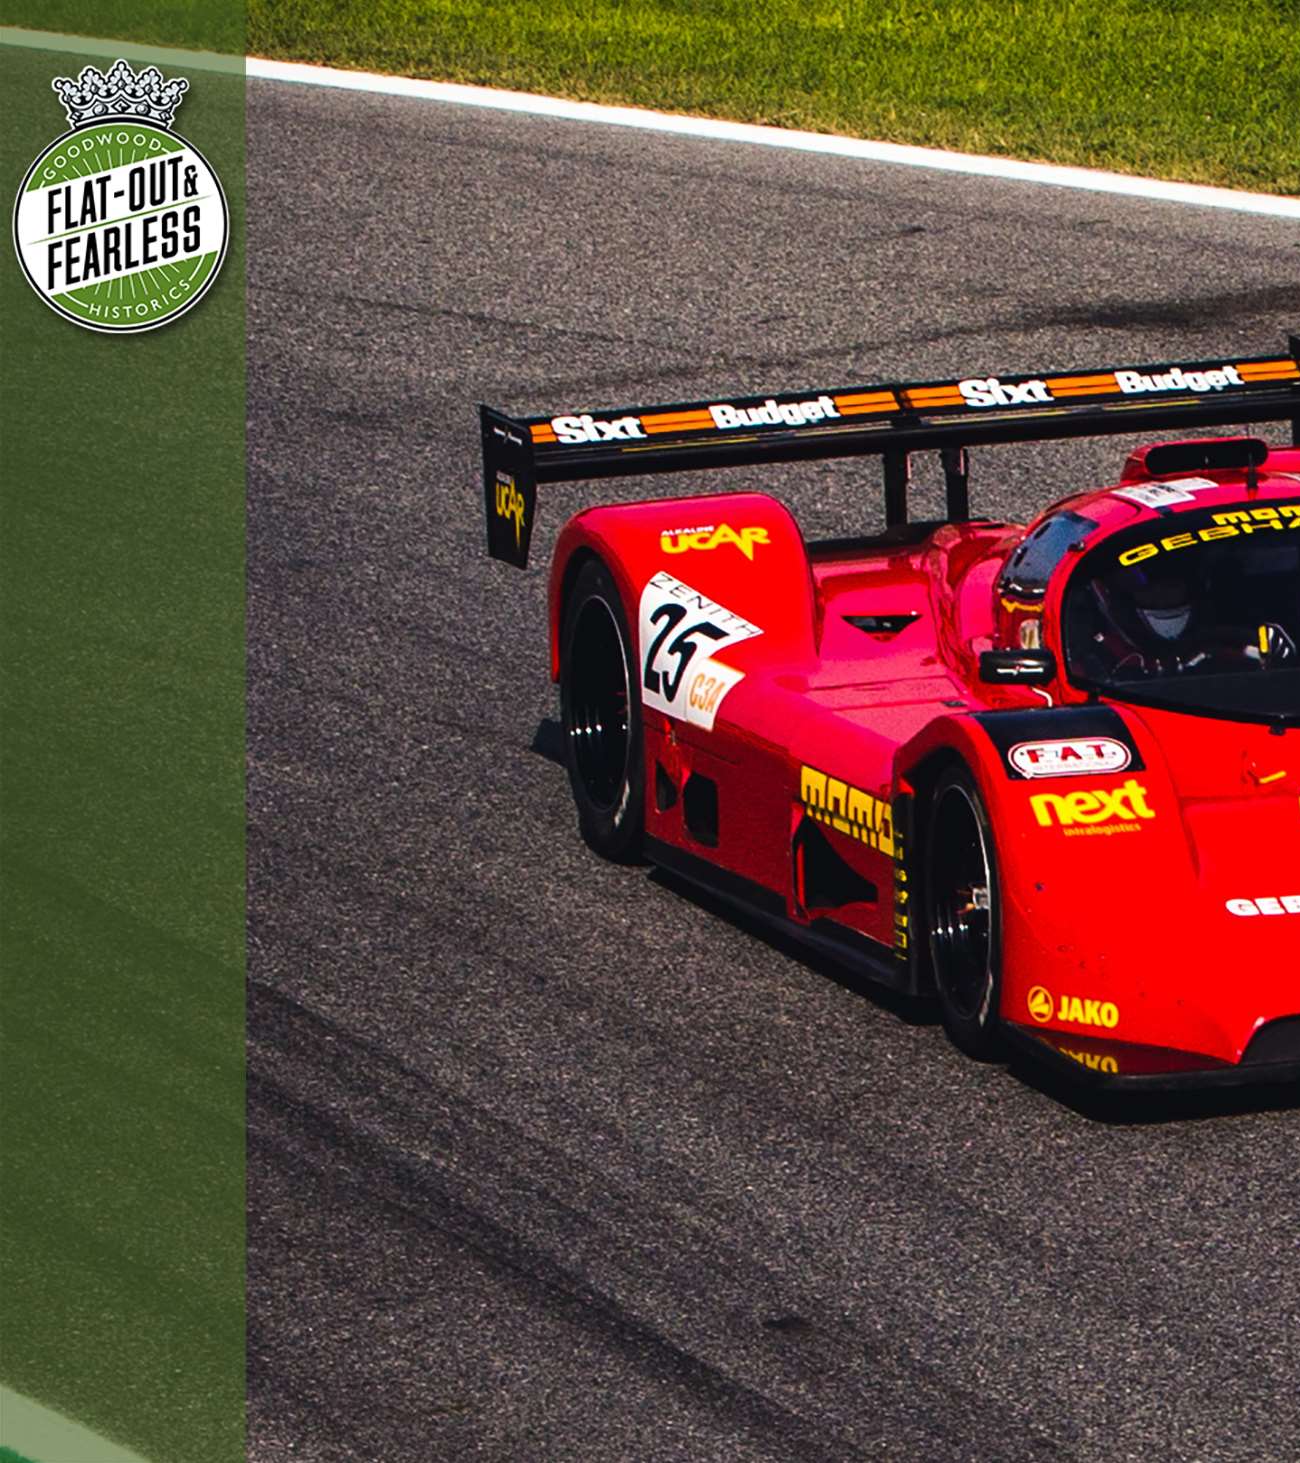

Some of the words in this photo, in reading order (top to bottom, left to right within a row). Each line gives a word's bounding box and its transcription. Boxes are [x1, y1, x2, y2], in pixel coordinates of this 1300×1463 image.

[957, 376, 1054, 407] Sixt
[1113, 365, 1245, 394] Budget
[550, 415, 648, 444] Sixt
[708, 395, 841, 430] Budget
[661, 523, 771, 561] UCAR
[649, 573, 762, 636] ZENITH
[644, 602, 731, 703] 25
[1029, 779, 1155, 827] next
[1057, 995, 1119, 1028] JAKO
